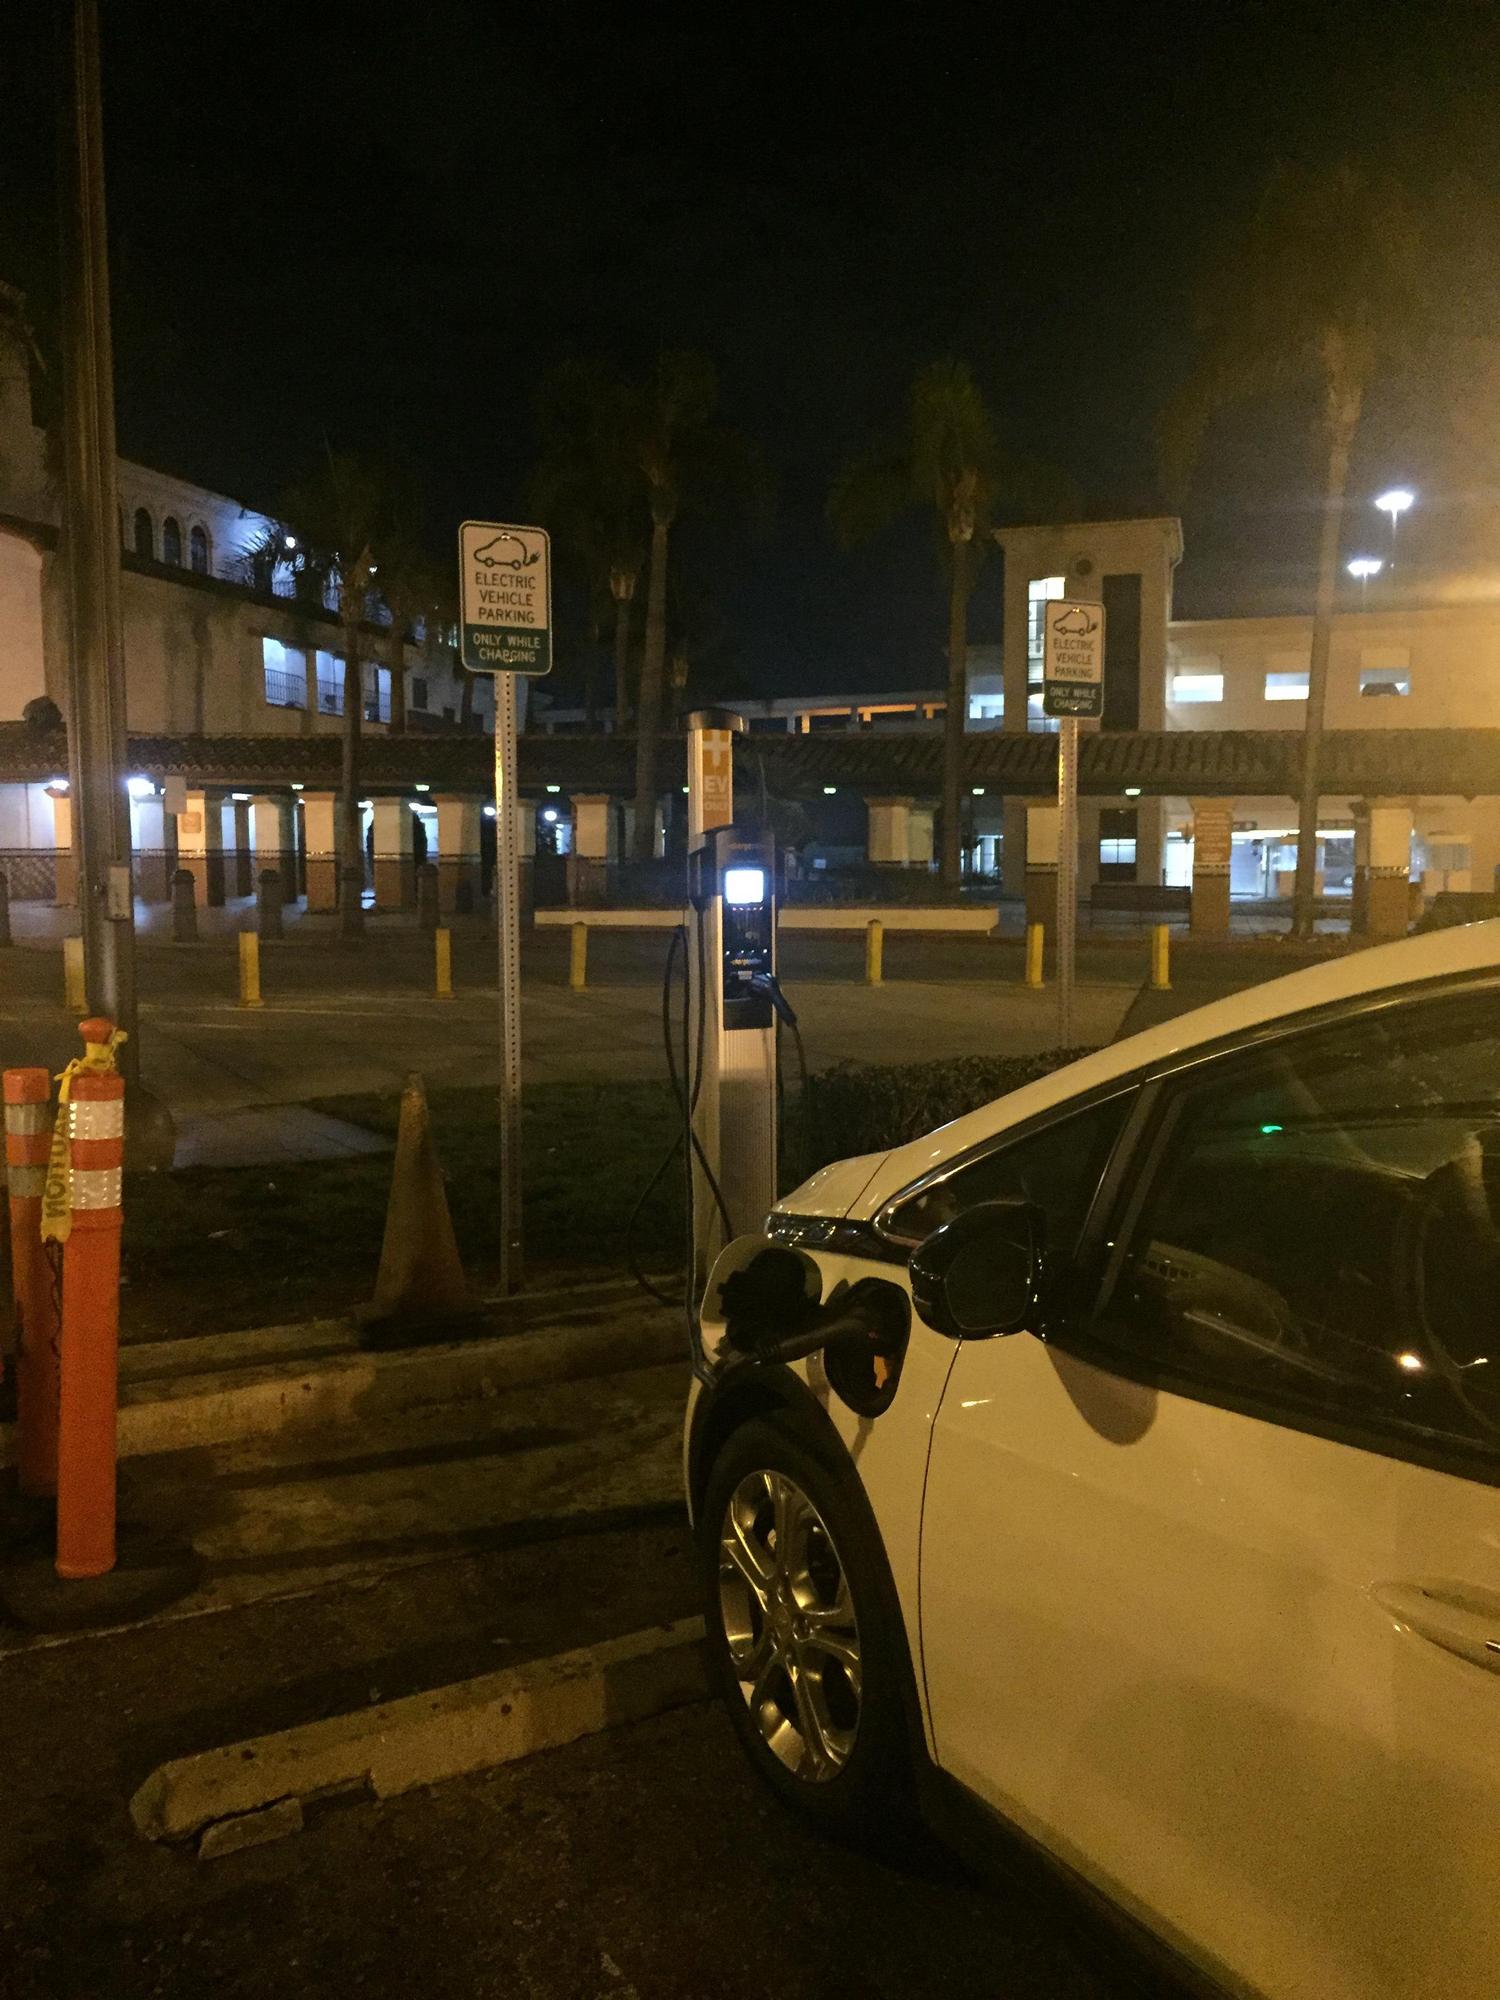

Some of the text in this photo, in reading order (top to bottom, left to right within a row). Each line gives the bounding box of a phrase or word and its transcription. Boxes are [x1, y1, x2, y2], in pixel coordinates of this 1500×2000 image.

[475, 572, 536, 589] ELECTRIC
[480, 590, 533, 606] VEHICLE
[478, 608, 535, 624] PARKING
[473, 632, 541, 649] ONLY WHILE
[1053, 639, 1094, 651] ELECTRIC
[479, 648, 536, 663] CHARGING
[1056, 653, 1092, 665] VEHICLE
[1054, 667, 1092, 679] PARKING
[1050, 687, 1097, 699] ONLY WHILE
[704, 775, 728, 793] EV
